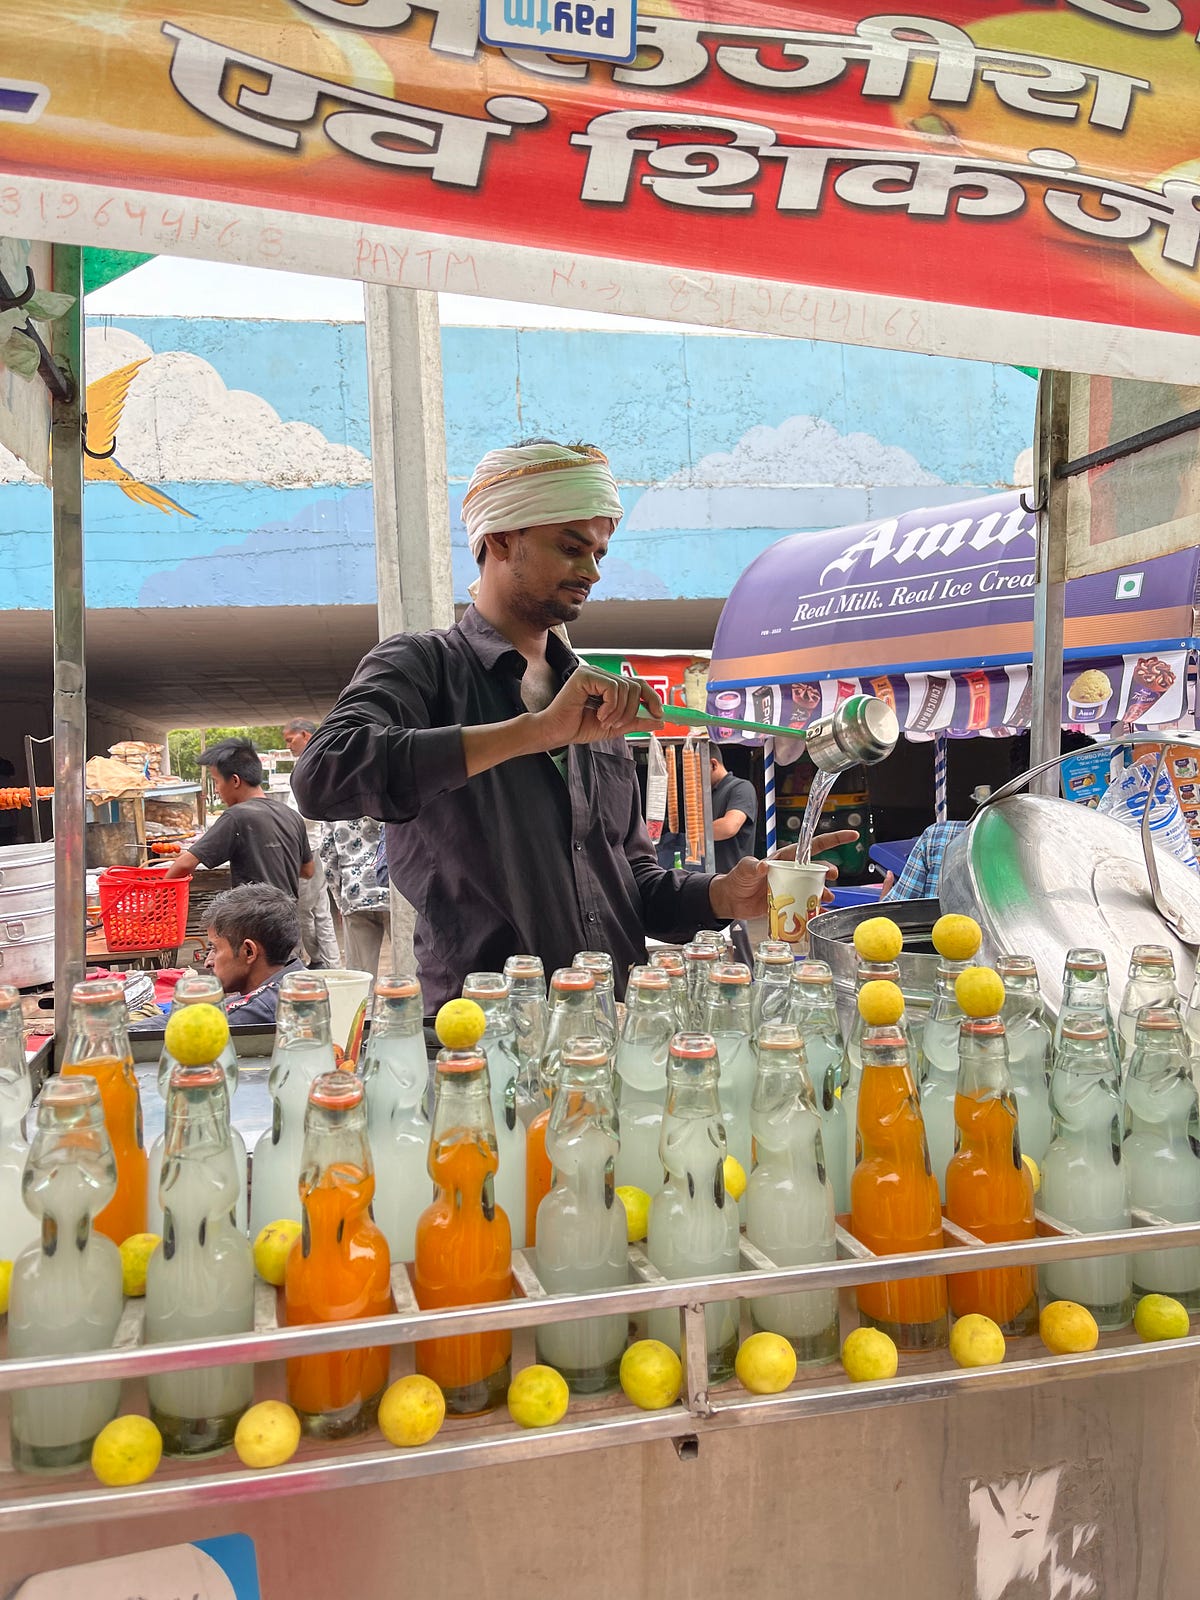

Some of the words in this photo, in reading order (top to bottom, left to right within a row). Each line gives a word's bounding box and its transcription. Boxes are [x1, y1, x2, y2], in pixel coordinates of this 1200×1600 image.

[161, 21, 548, 188] एवं
[356, 231, 480, 290] PAYTM
[819, 506, 1036, 587] Amu
[793, 597, 834, 622] Real
[834, 590, 883, 614] Milk.
[889, 581, 934, 608] Real
[939, 578, 971, 600] Ice
[979, 570, 1036, 593] Crea
